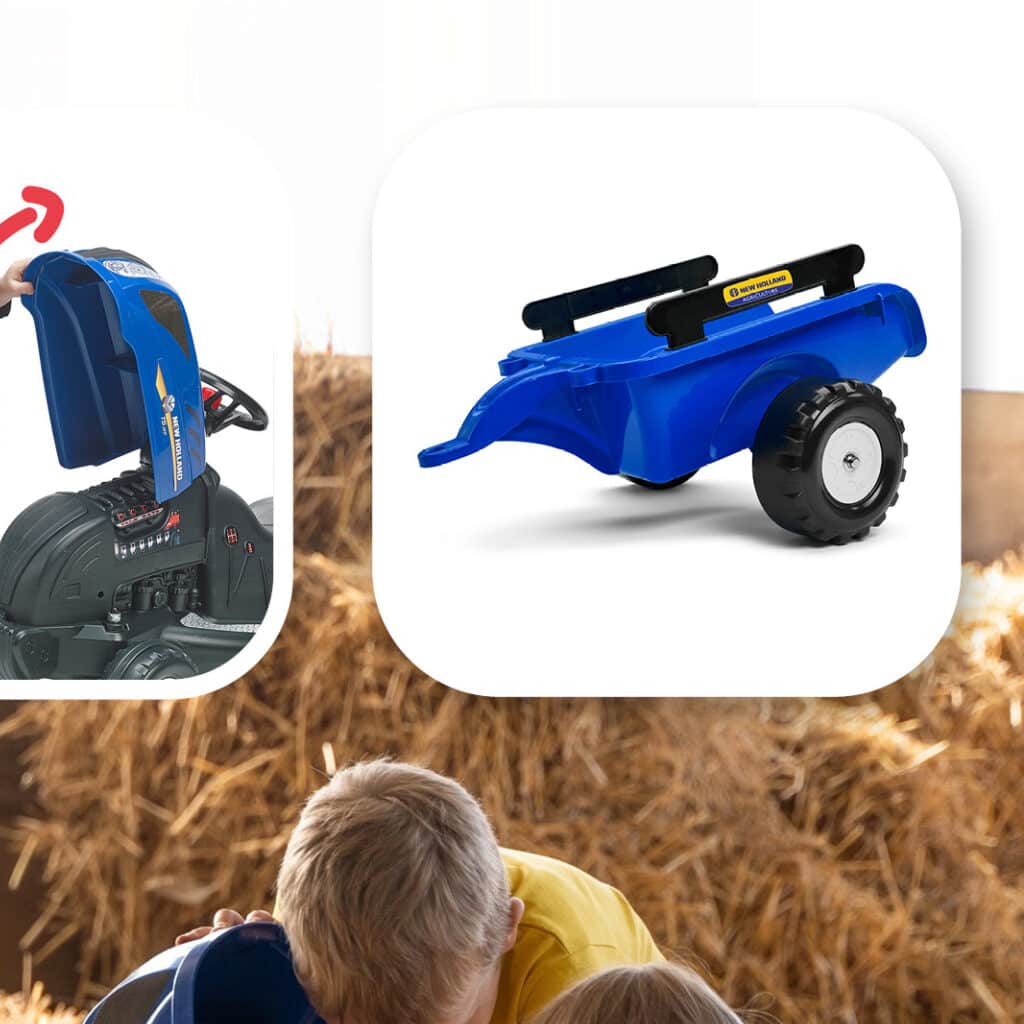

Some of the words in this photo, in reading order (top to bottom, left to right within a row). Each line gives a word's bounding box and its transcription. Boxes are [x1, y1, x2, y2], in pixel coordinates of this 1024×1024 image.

[740, 284, 756, 293] NEW
[757, 275, 786, 288] HOLLAND
[172, 416, 180, 438] NEW
[175, 439, 183, 481] HOLLAND
